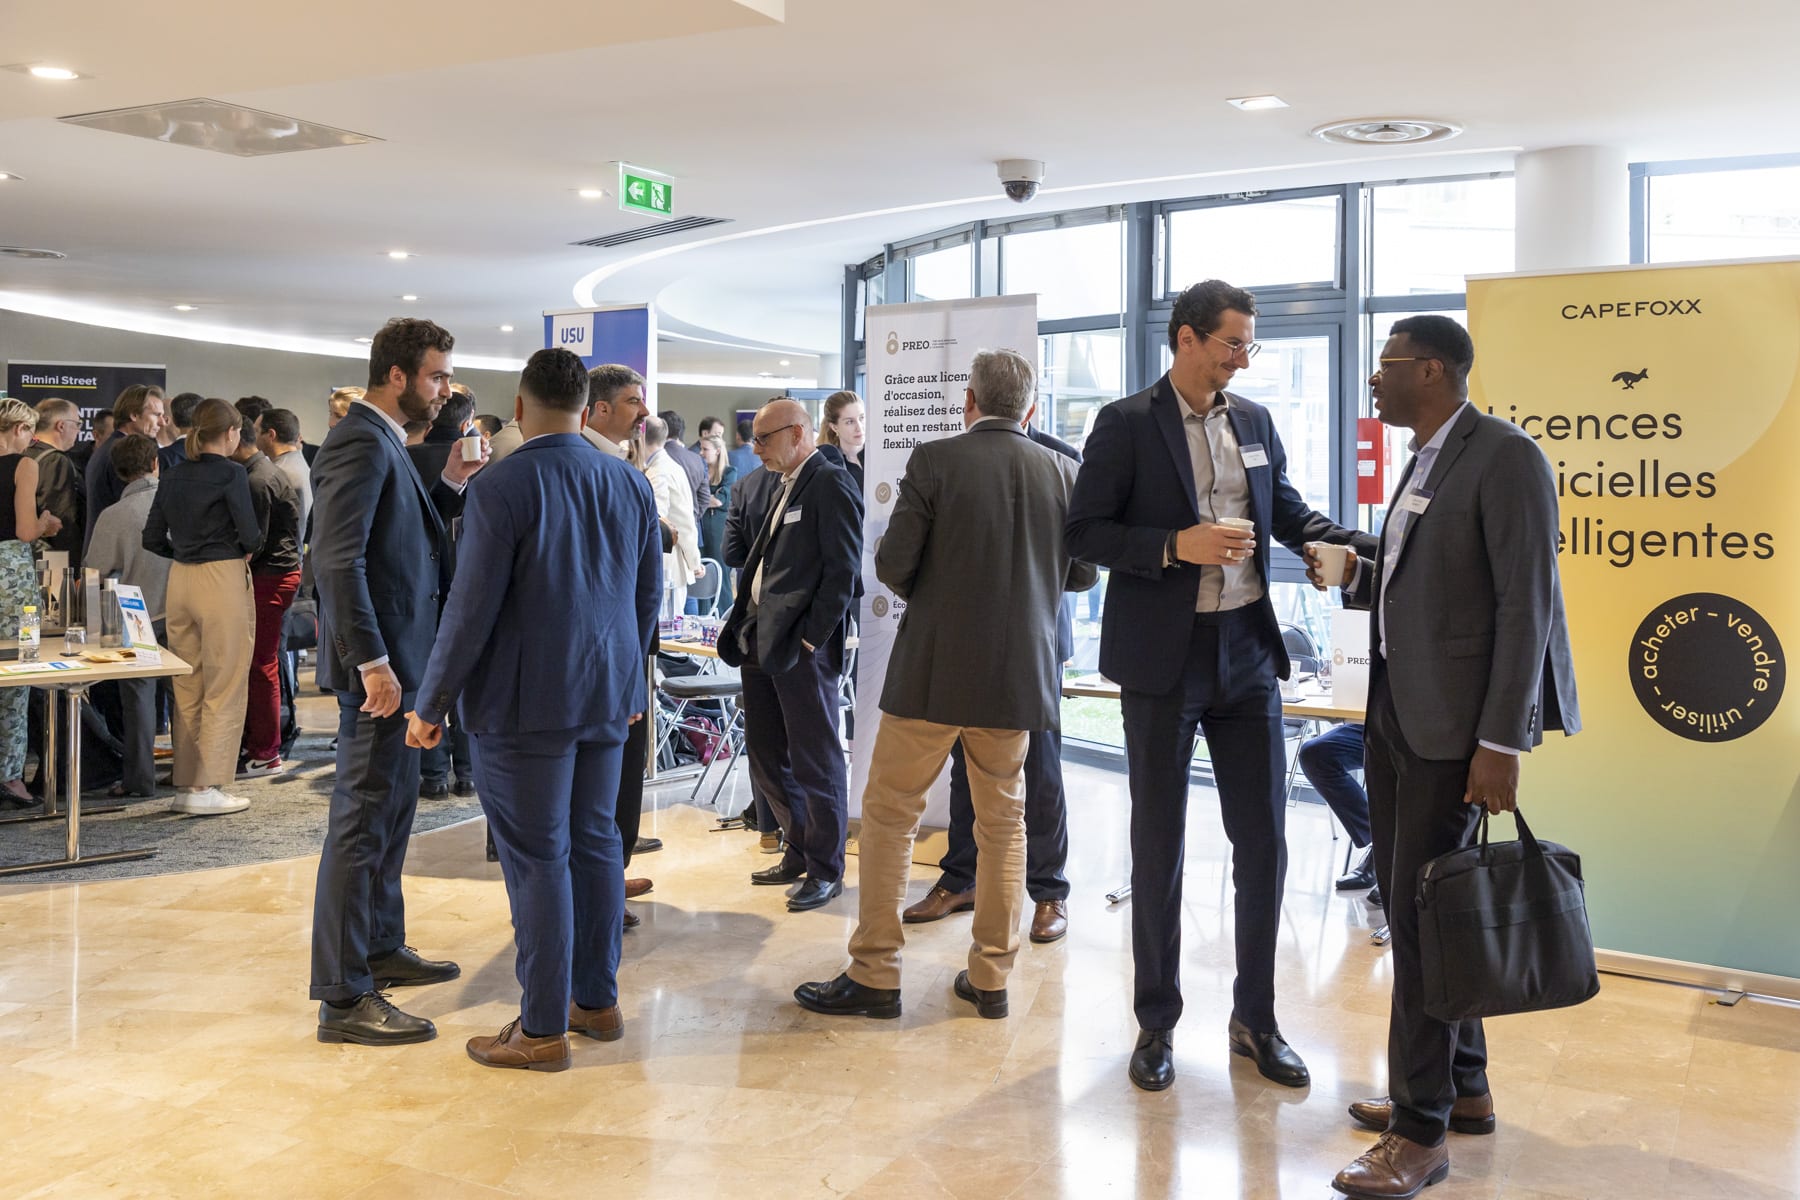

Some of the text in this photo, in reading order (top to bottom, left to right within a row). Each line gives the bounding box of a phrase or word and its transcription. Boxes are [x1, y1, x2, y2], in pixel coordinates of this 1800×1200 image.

[1561, 298, 1703, 320] CAPEFOXX
[562, 327, 584, 344] USU
[902, 340, 930, 351] PREO
[21, 374, 97, 386] Rimini Street
[884, 373, 915, 385] Grâce
[917, 374, 938, 383] aux
[884, 388, 944, 400] d'occasion,
[884, 405, 925, 416] réalisez
[927, 404, 947, 416] des
[884, 421, 962, 433] tout en restant
[1557, 458, 1717, 499] icielles
[893, 598, 907, 609] Éco
[1640, 606, 1699, 680] acheter
[1727, 612, 1777, 692] vendre
[1660, 700, 1743, 734] utiliser
